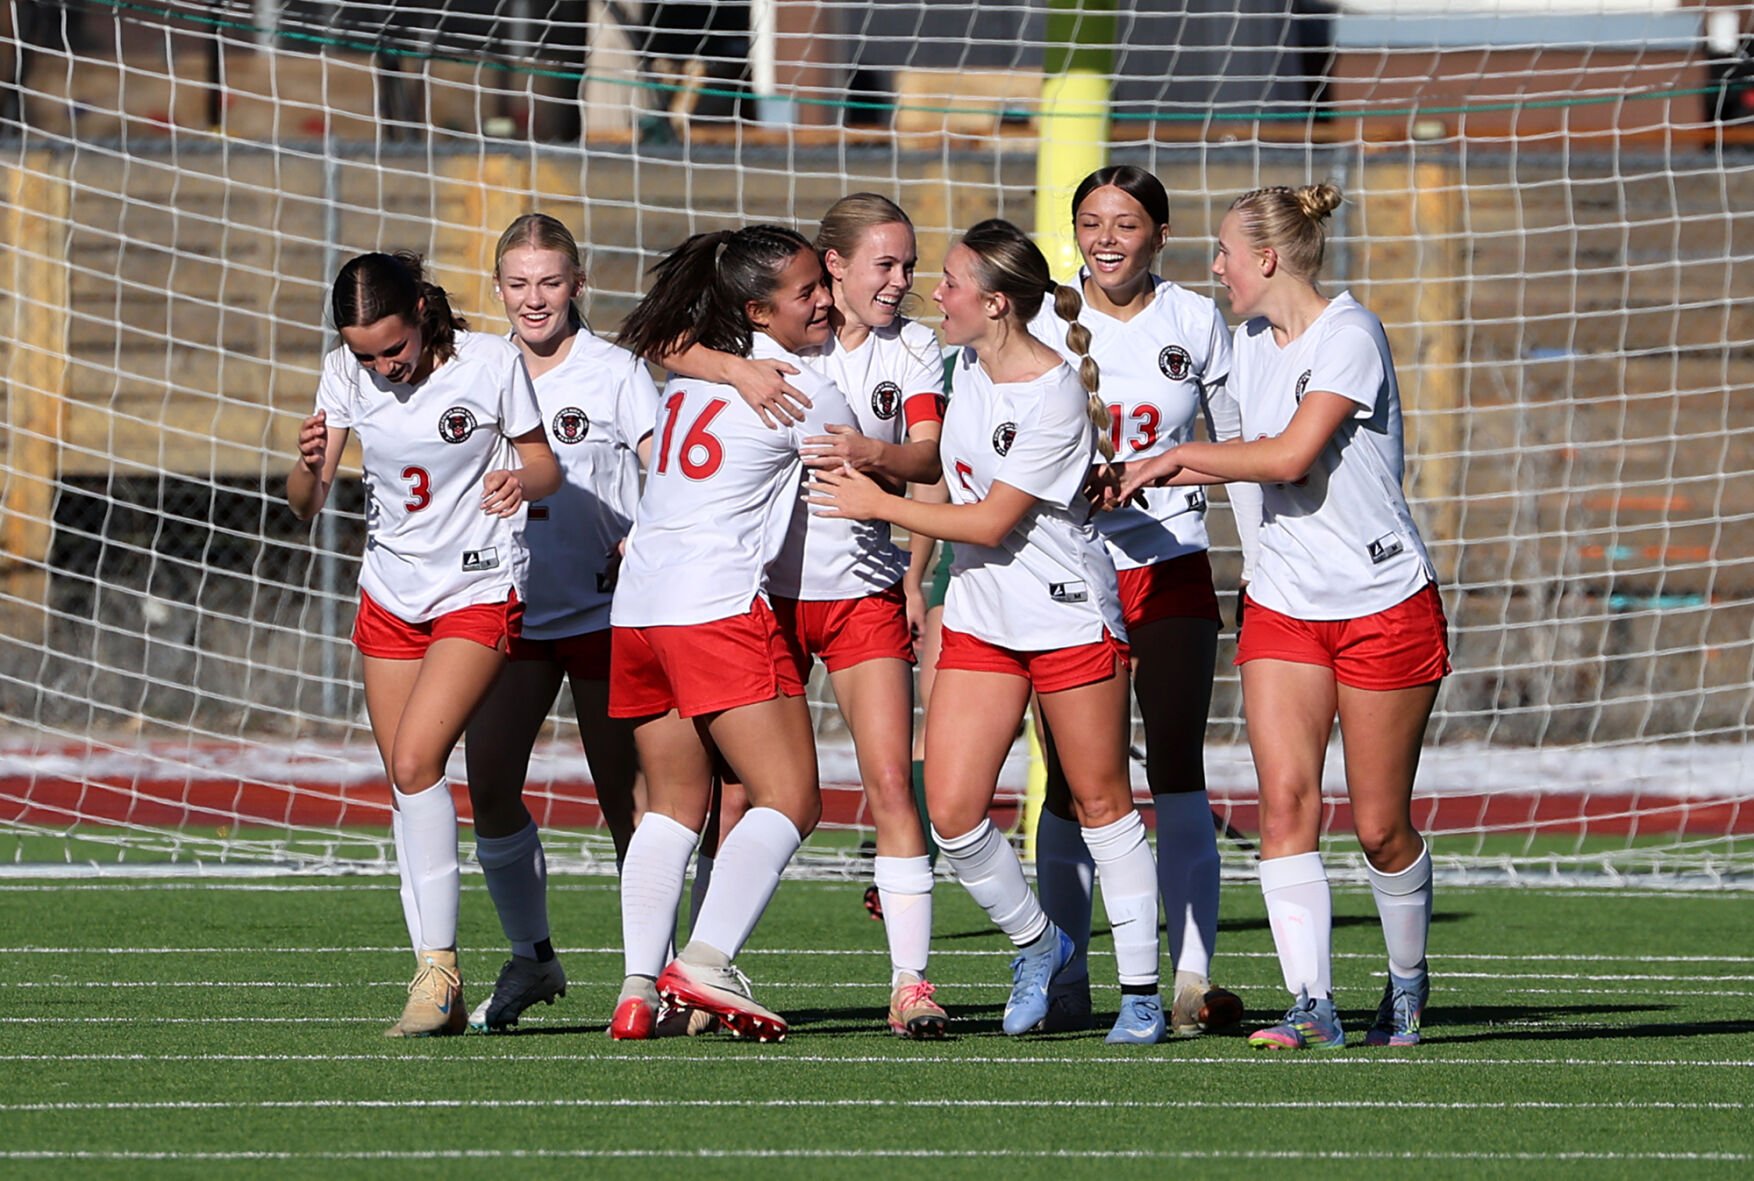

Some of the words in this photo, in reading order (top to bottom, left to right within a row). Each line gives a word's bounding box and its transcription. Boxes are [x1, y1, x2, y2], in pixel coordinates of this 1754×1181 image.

[657, 390, 731, 482] 16
[1105, 402, 1162, 454] 13
[400, 465, 433, 514] 3
